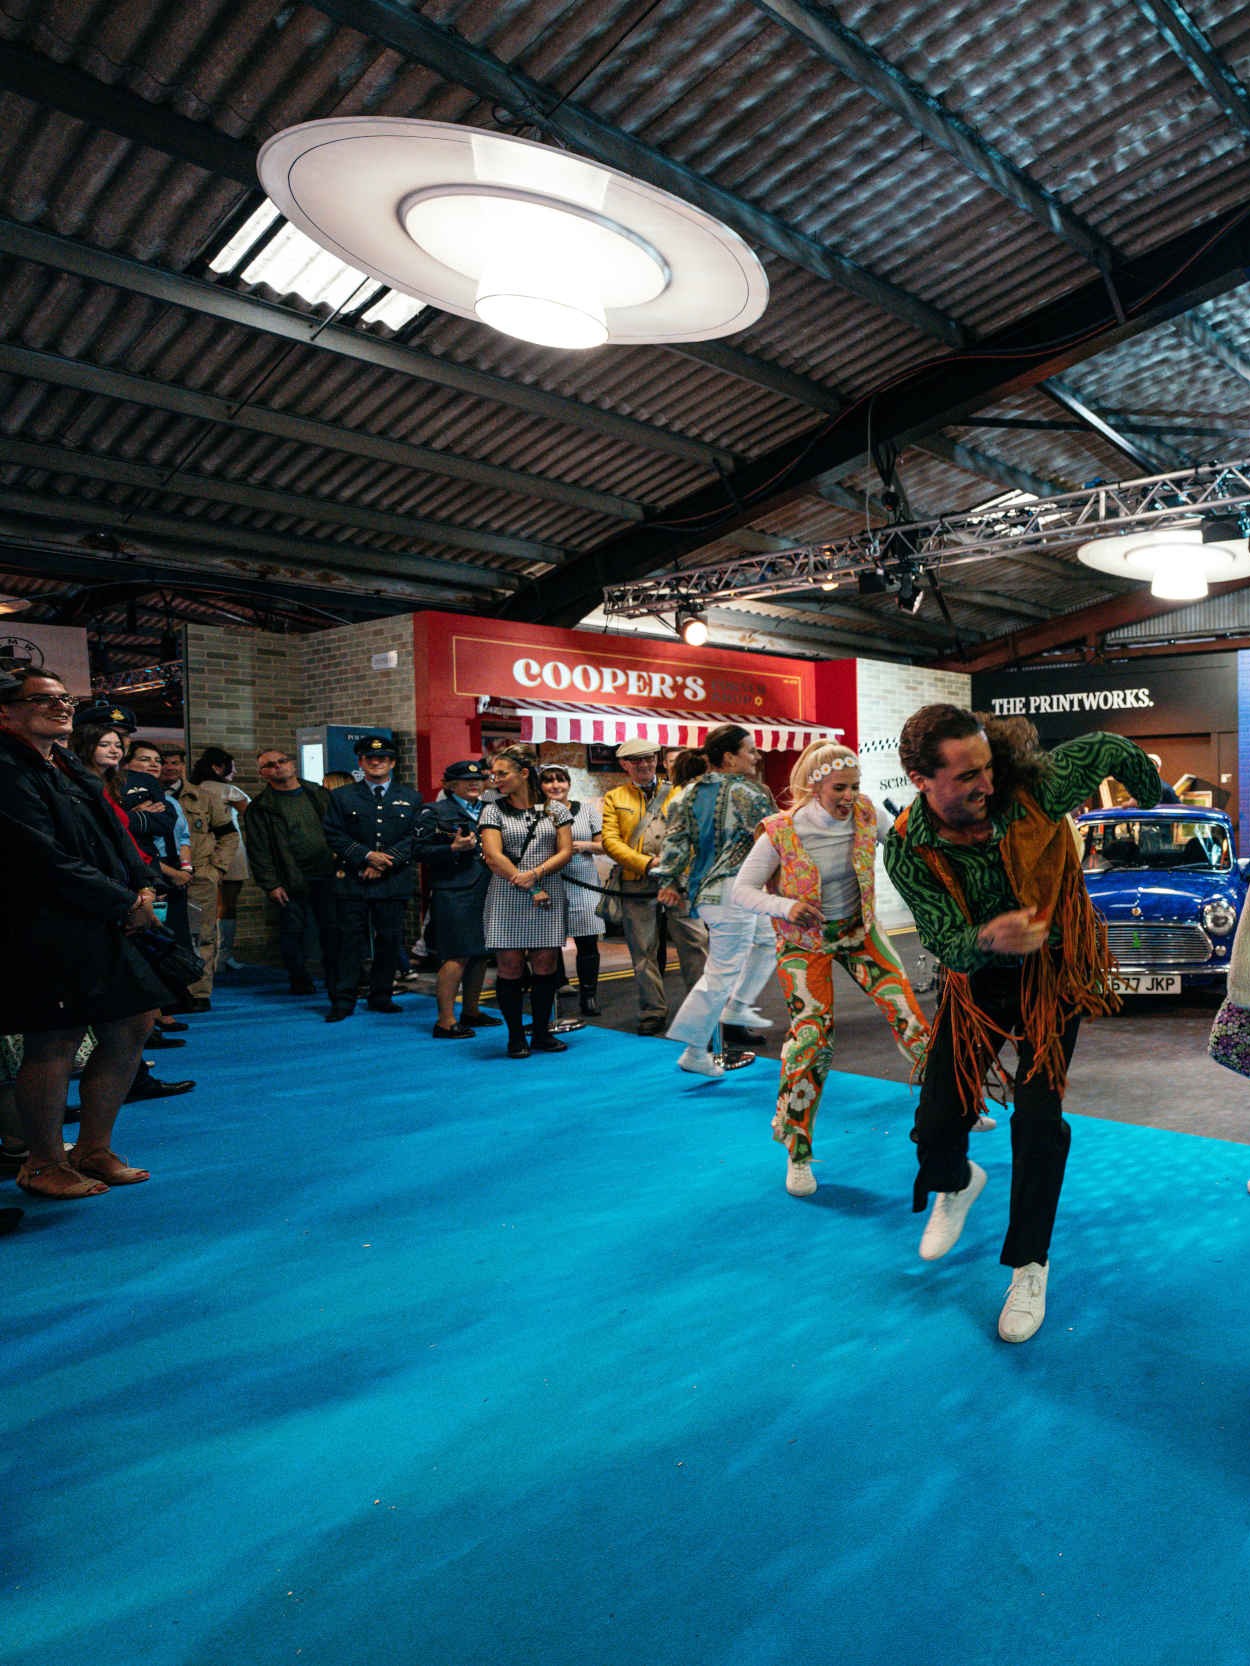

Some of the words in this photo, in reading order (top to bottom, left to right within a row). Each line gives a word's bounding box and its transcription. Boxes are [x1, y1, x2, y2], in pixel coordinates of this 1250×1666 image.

[512, 658, 706, 702] COOPER'S
[992, 698, 1026, 716] THE
[1029, 688, 1155, 714] PRINTWORKS.
[1104, 976, 1141, 992] 677
[1145, 976, 1176, 992] JKP
